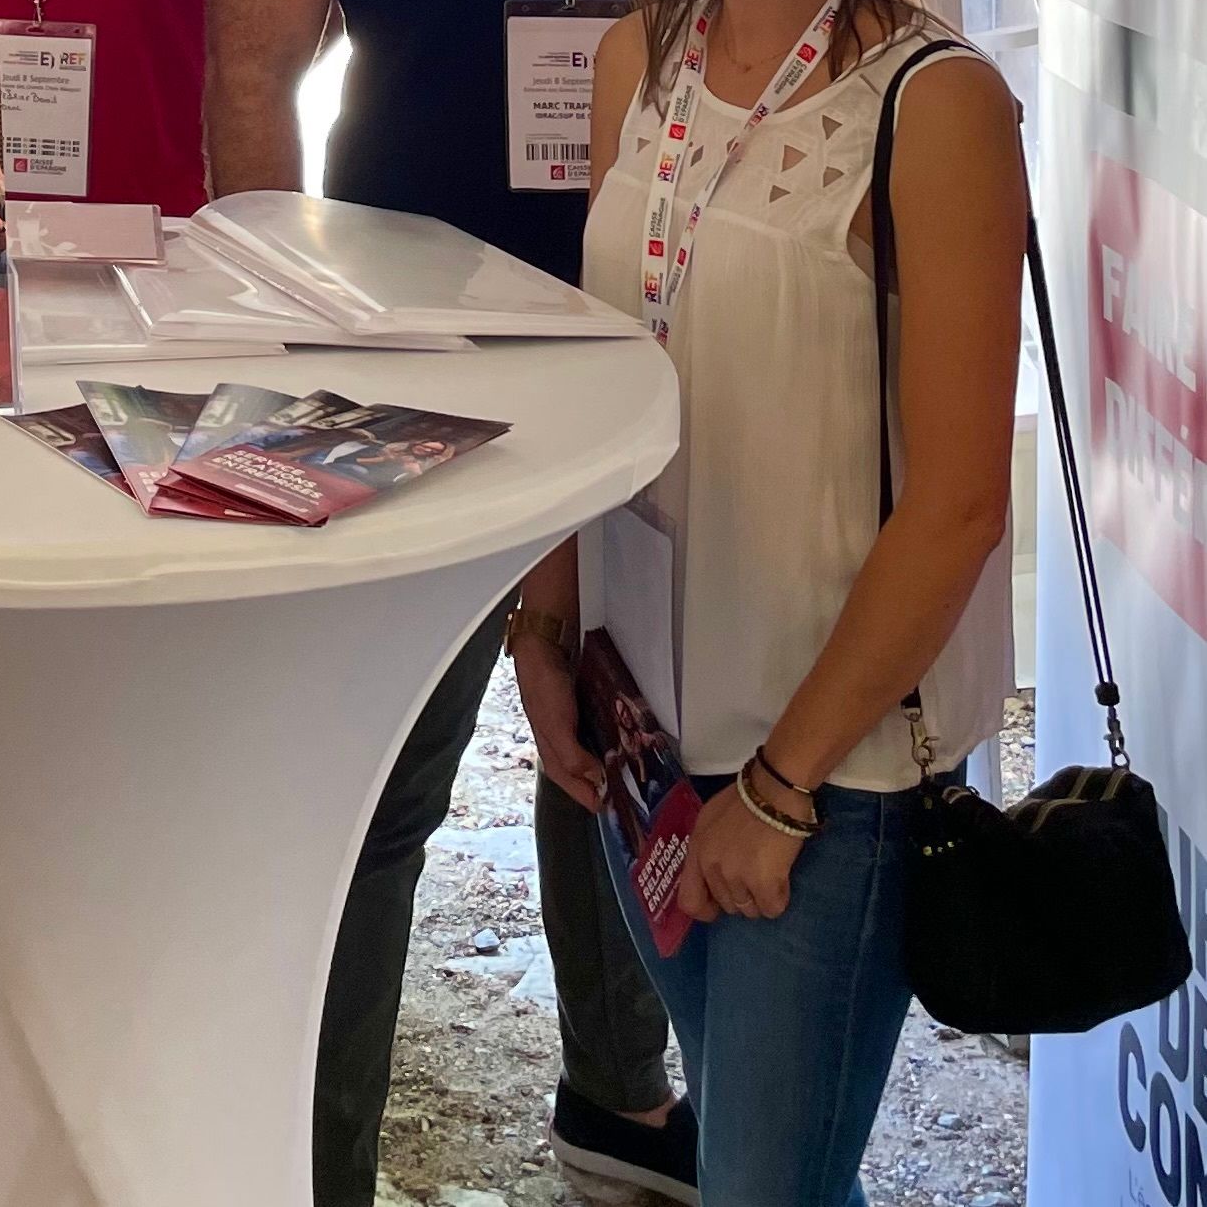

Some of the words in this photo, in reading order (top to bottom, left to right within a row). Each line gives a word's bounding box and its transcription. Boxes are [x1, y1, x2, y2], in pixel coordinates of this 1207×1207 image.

[533, 102, 560, 110] MARC
[638, 837, 665, 887] SERVICE
[643, 833, 679, 900] RELATIONS
